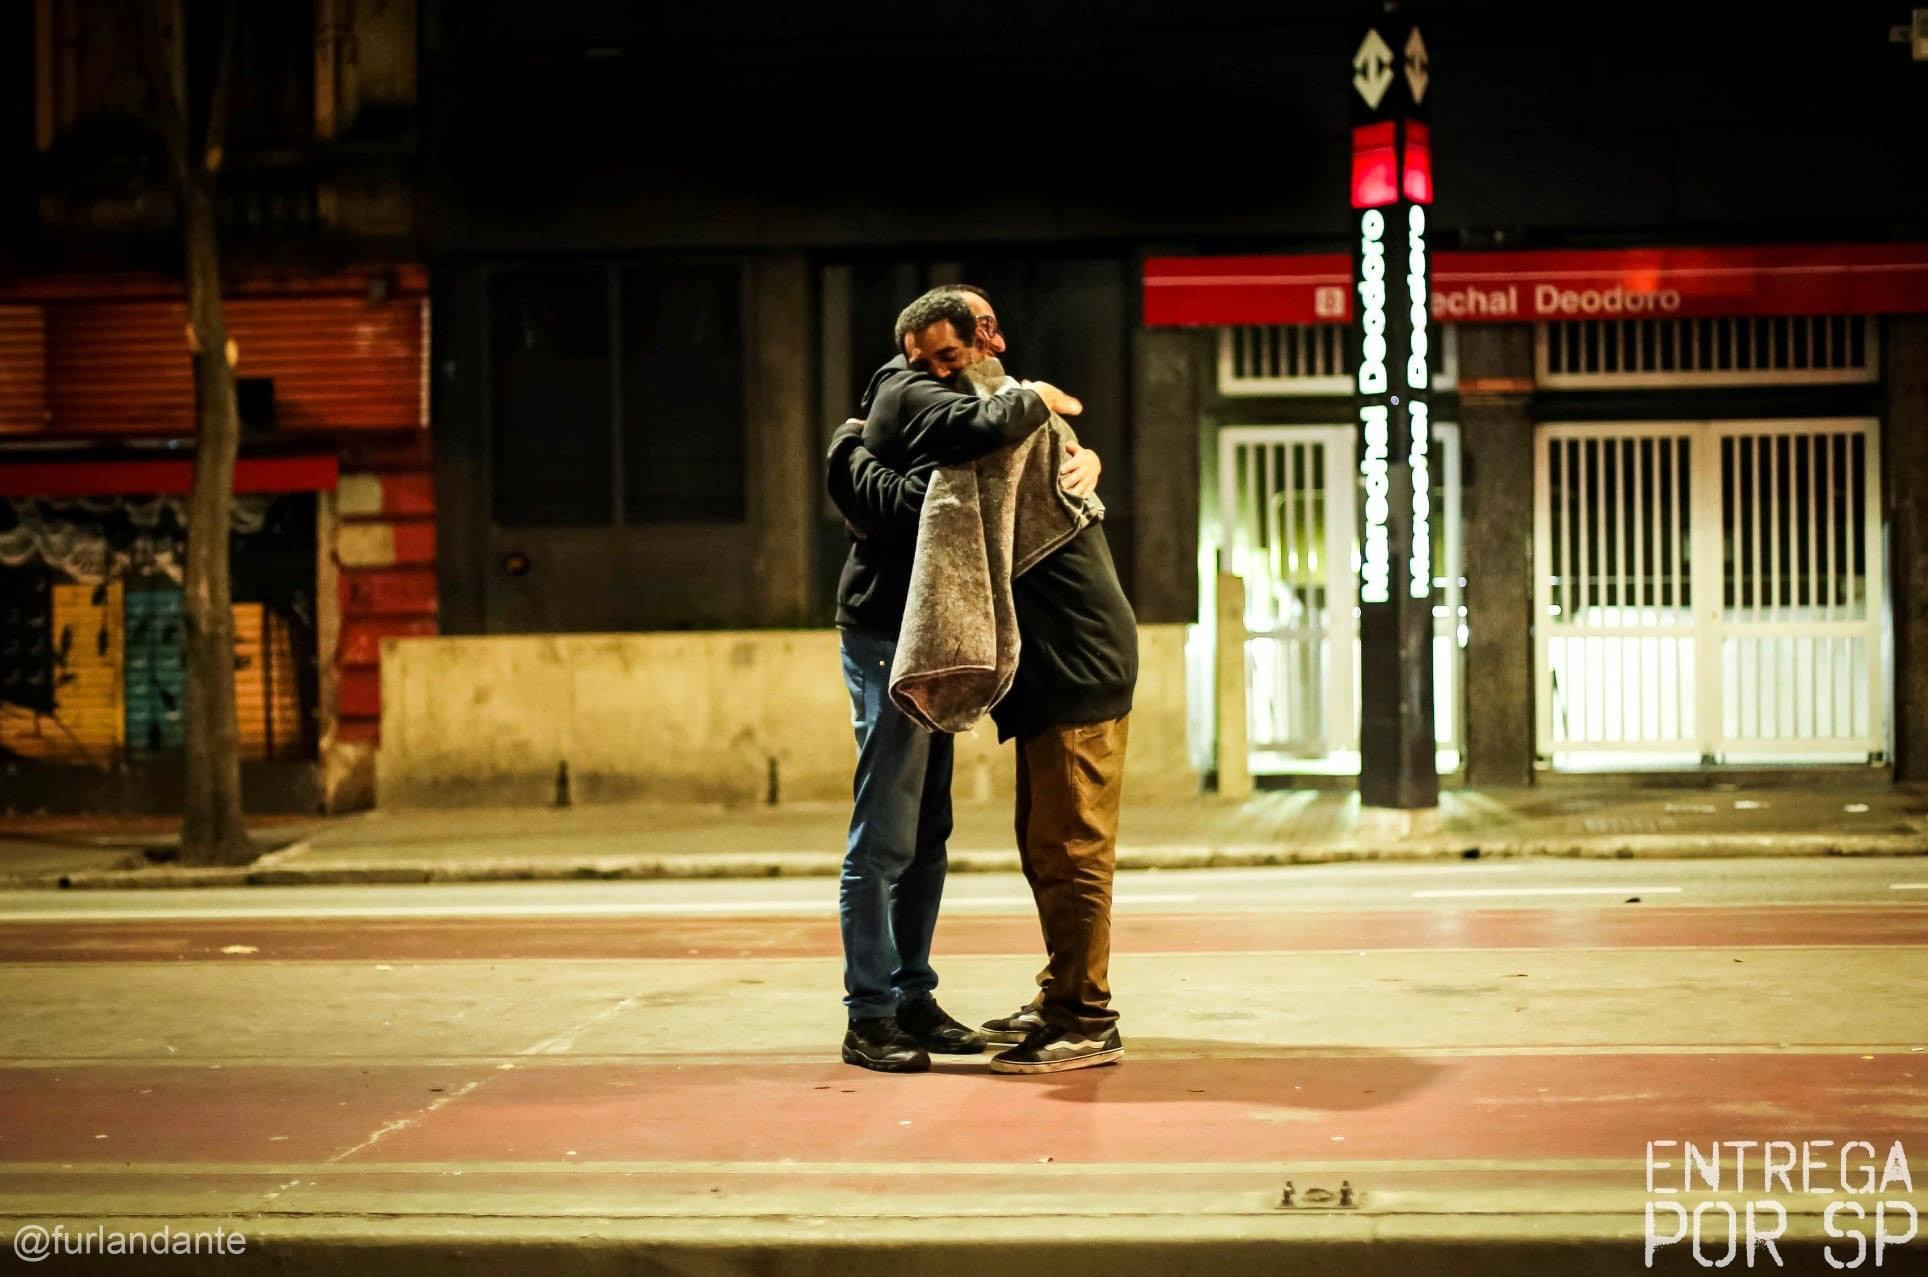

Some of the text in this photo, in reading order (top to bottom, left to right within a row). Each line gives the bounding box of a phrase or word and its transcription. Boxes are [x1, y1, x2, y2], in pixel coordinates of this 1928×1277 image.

[1358, 208, 1388, 395] Deodoro
[1431, 284, 1681, 316] echal Deodoro
